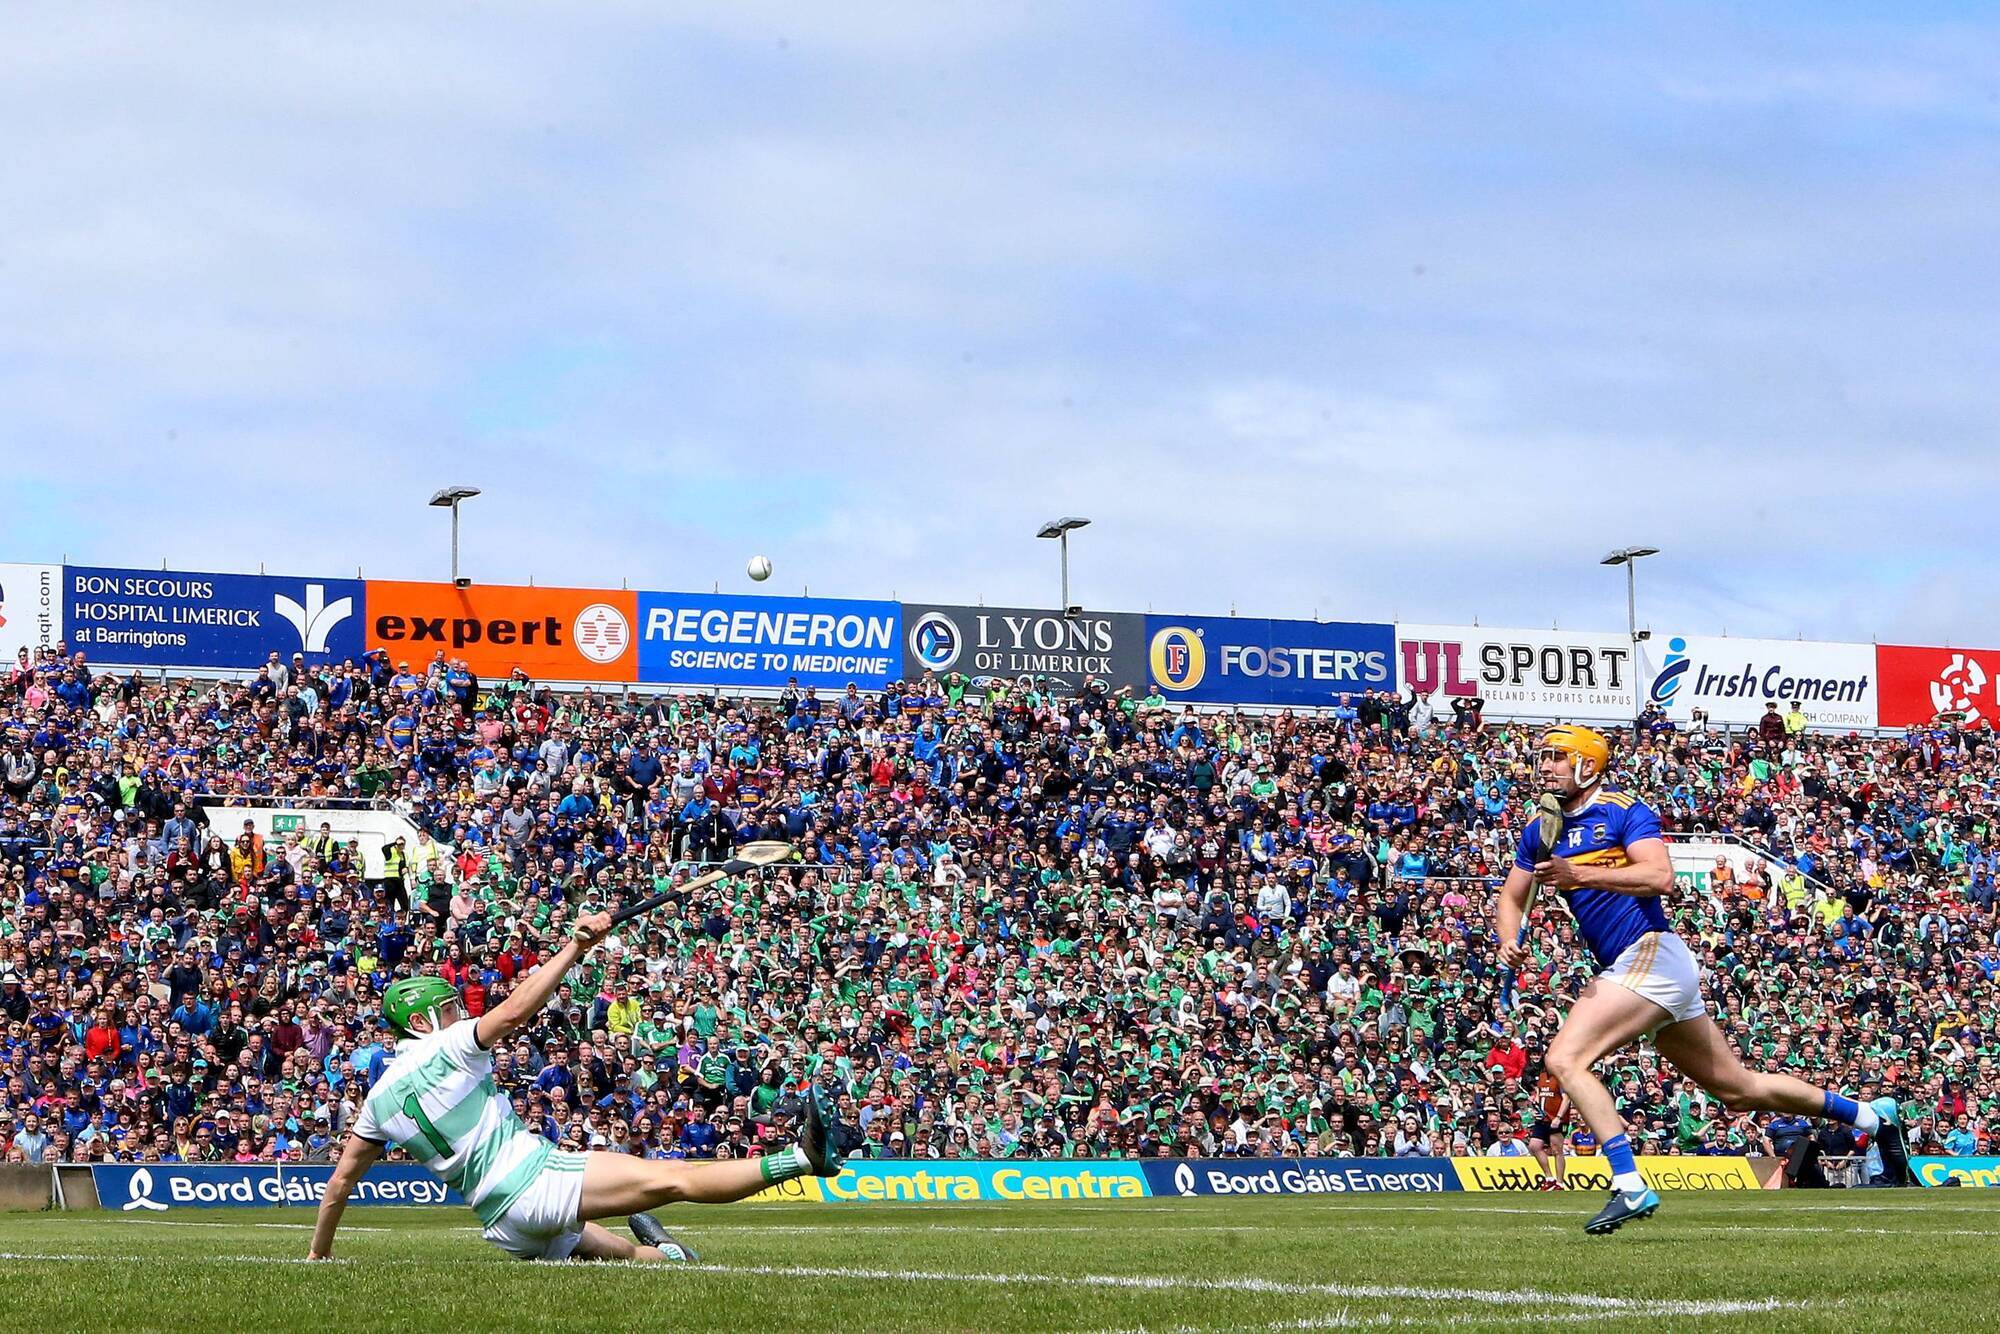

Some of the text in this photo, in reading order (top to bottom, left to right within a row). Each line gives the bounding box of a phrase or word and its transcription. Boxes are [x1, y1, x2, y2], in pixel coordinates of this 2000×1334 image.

[75, 576, 213, 600] BON SECOURS
[75, 602, 260, 628] HOSPITAL LIMERICK
[645, 607, 894, 649] REGENERON
[75, 627, 187, 648] at Barringtons
[376, 615, 562, 648] expert
[976, 615, 1114, 652] LYONS
[670, 650, 888, 675] SCIENCE TO MEDICINE
[975, 652, 1113, 674] OF LIMERICK
[1220, 645, 1387, 682] FOSTER'S
[1401, 640, 1478, 697] UL
[1481, 643, 1628, 688] SPORT
[1694, 663, 1868, 702] Irish Cement
[1480, 690, 1631, 706] IRELAND'S SPORTS CAMPUS
[1819, 713, 1869, 724] COMPANY
[1567, 831, 1582, 848] 14
[403, 1092, 455, 1159] 1
[169, 1175, 448, 1203] Bord Gáis nergy
[825, 1168, 981, 1200] Centra
[991, 1169, 1143, 1199] Centra
[1207, 1168, 1443, 1194] Bord Gáis Energy
[1645, 1167, 1747, 1190] Ireland
